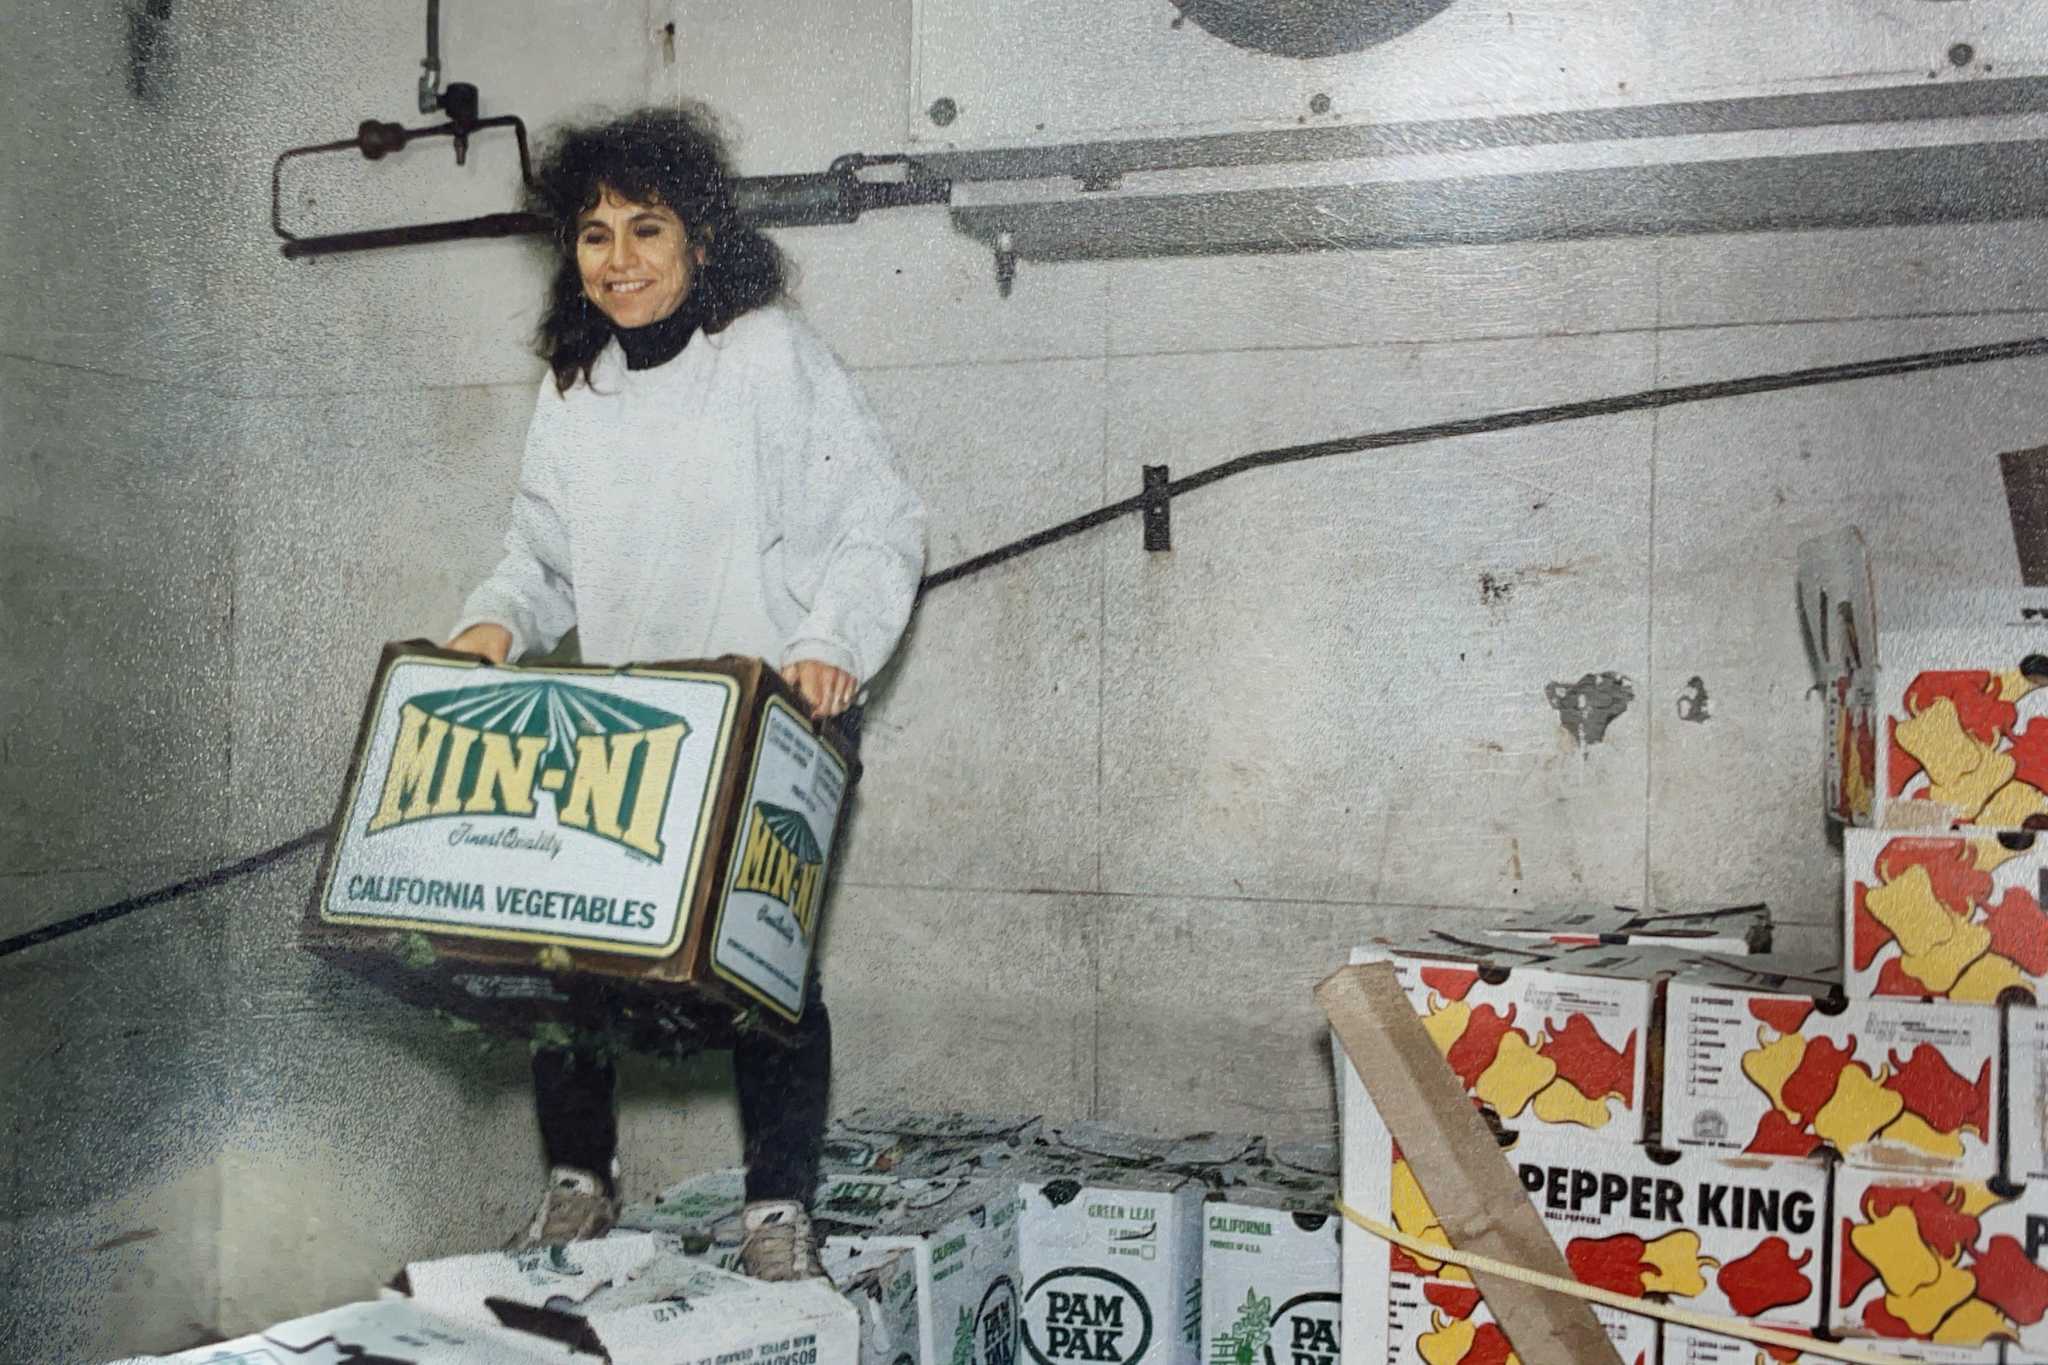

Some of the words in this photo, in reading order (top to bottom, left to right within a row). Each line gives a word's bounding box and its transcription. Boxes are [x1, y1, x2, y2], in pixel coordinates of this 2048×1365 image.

[366, 702, 690, 862] MIN-NI
[502, 826, 563, 861] Quality
[348, 875, 486, 911] CALIFORNIA
[496, 887, 658, 929] VEGETABLES
[1088, 1204, 1124, 1219] GREEN
[1129, 1207, 1155, 1221] LEAF
[1519, 1163, 1684, 1223] PEPPER
[1698, 1184, 1815, 1235] KING
[1209, 1215, 1272, 1236] CALIFORNIA
[1046, 1291, 1124, 1328] PAM
[1046, 1326, 1123, 1362] PAK
[1290, 1315, 1343, 1354] PA
